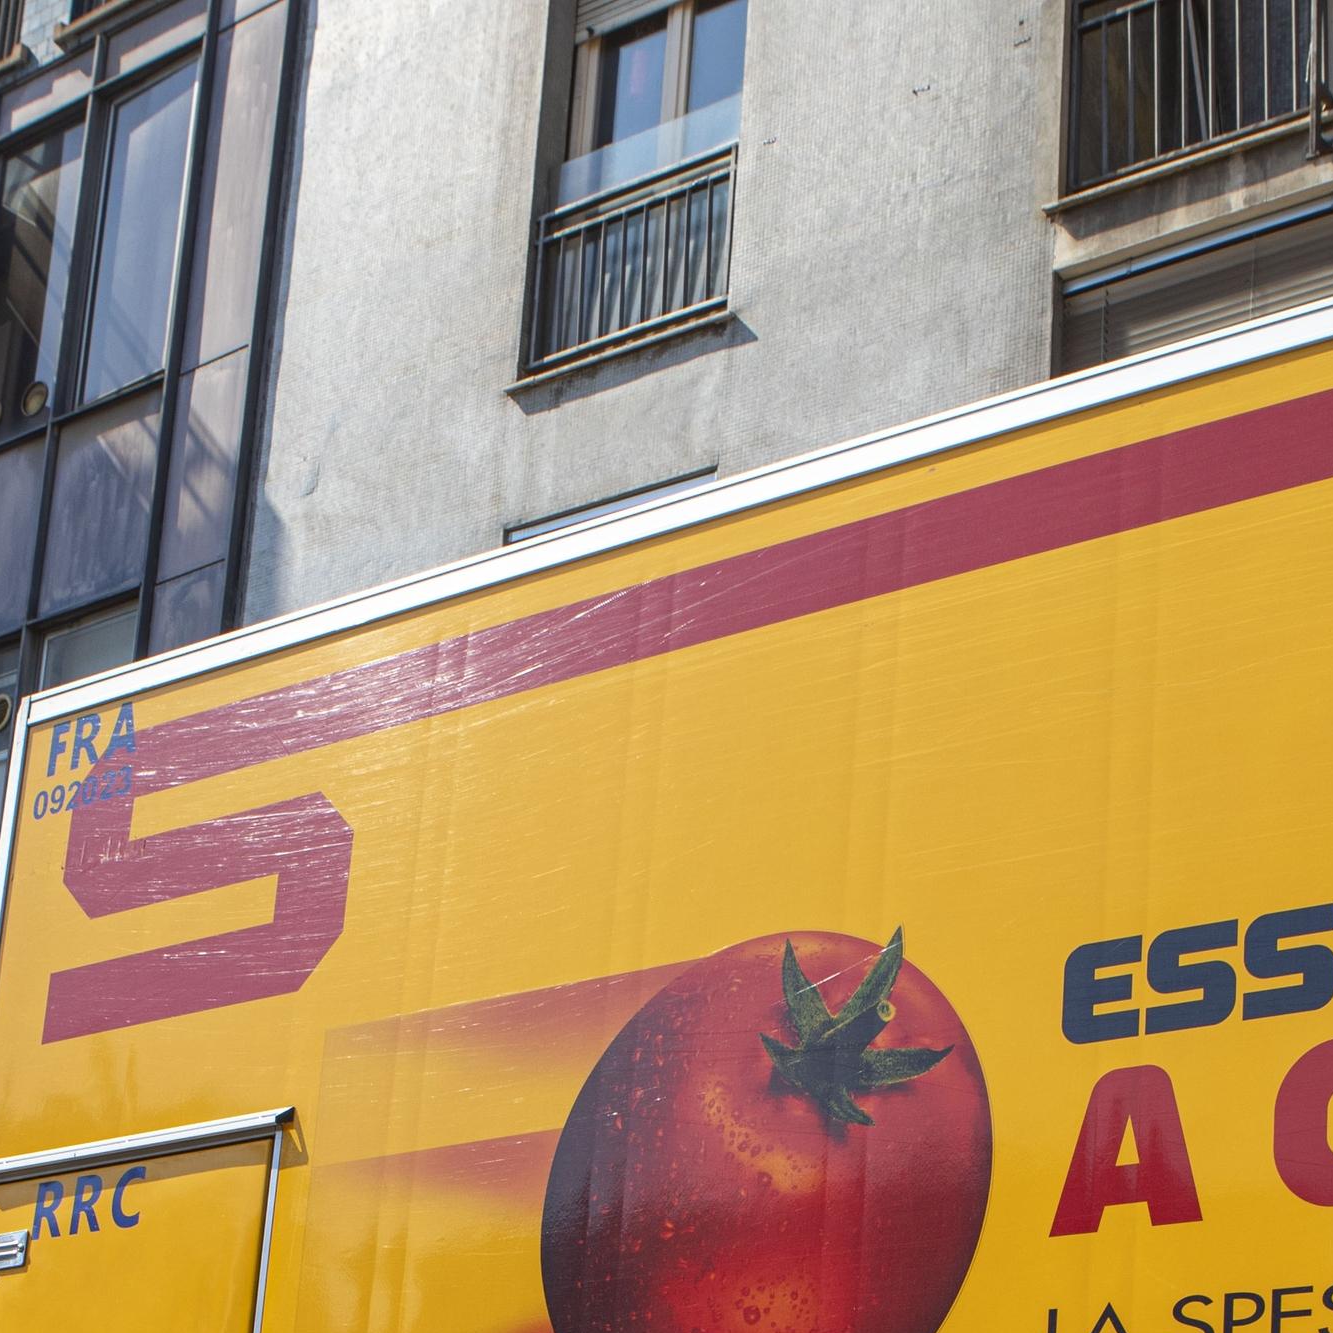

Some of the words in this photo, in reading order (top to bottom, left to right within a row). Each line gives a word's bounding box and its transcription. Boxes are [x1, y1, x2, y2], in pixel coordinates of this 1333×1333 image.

[47, 702, 136, 777] FRA
[1048, 1064, 1203, 1238] A
[32, 1166, 146, 1240] RRC
